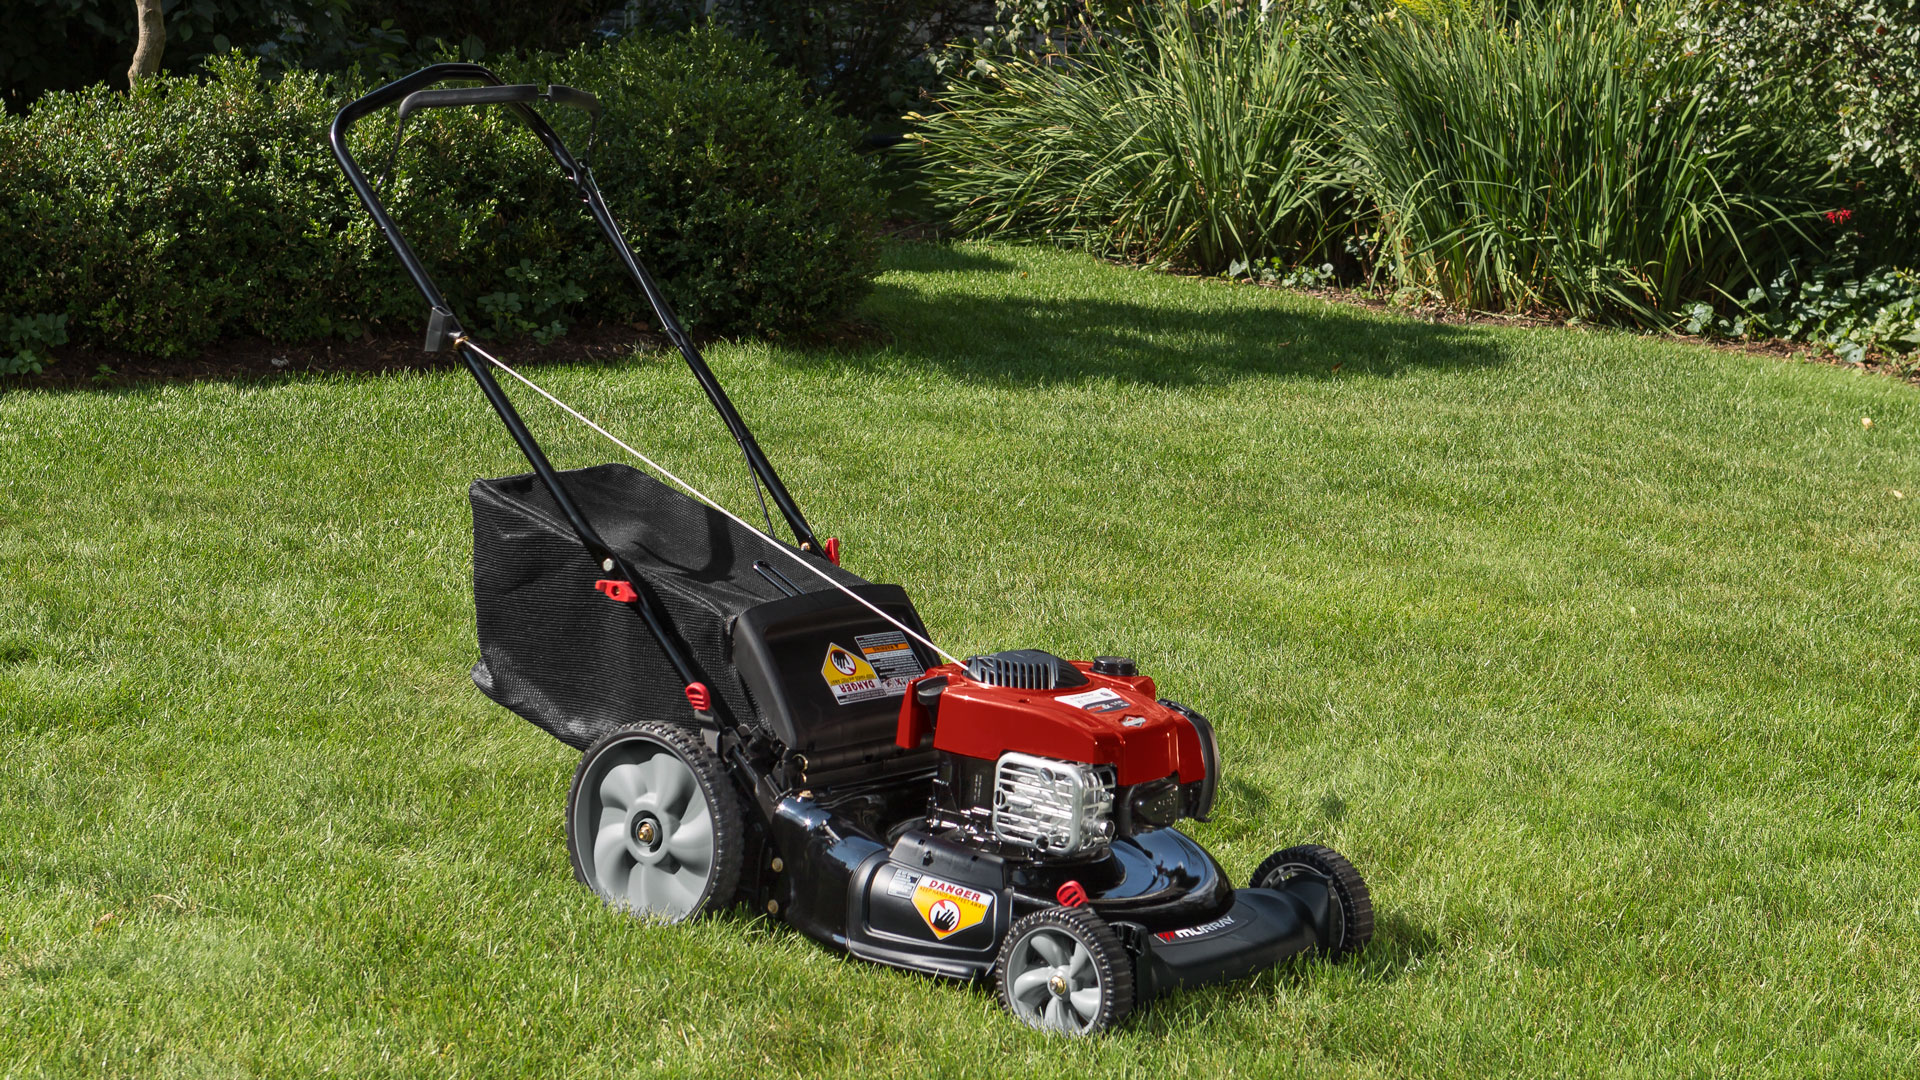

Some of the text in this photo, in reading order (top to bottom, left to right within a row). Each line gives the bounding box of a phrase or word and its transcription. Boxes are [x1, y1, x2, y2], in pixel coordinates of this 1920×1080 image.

[839, 680, 876, 693] DANGER
[929, 880, 981, 902] DANGER
[971, 902, 985, 910] AWAY
[1175, 916, 1235, 938] MURRAY
